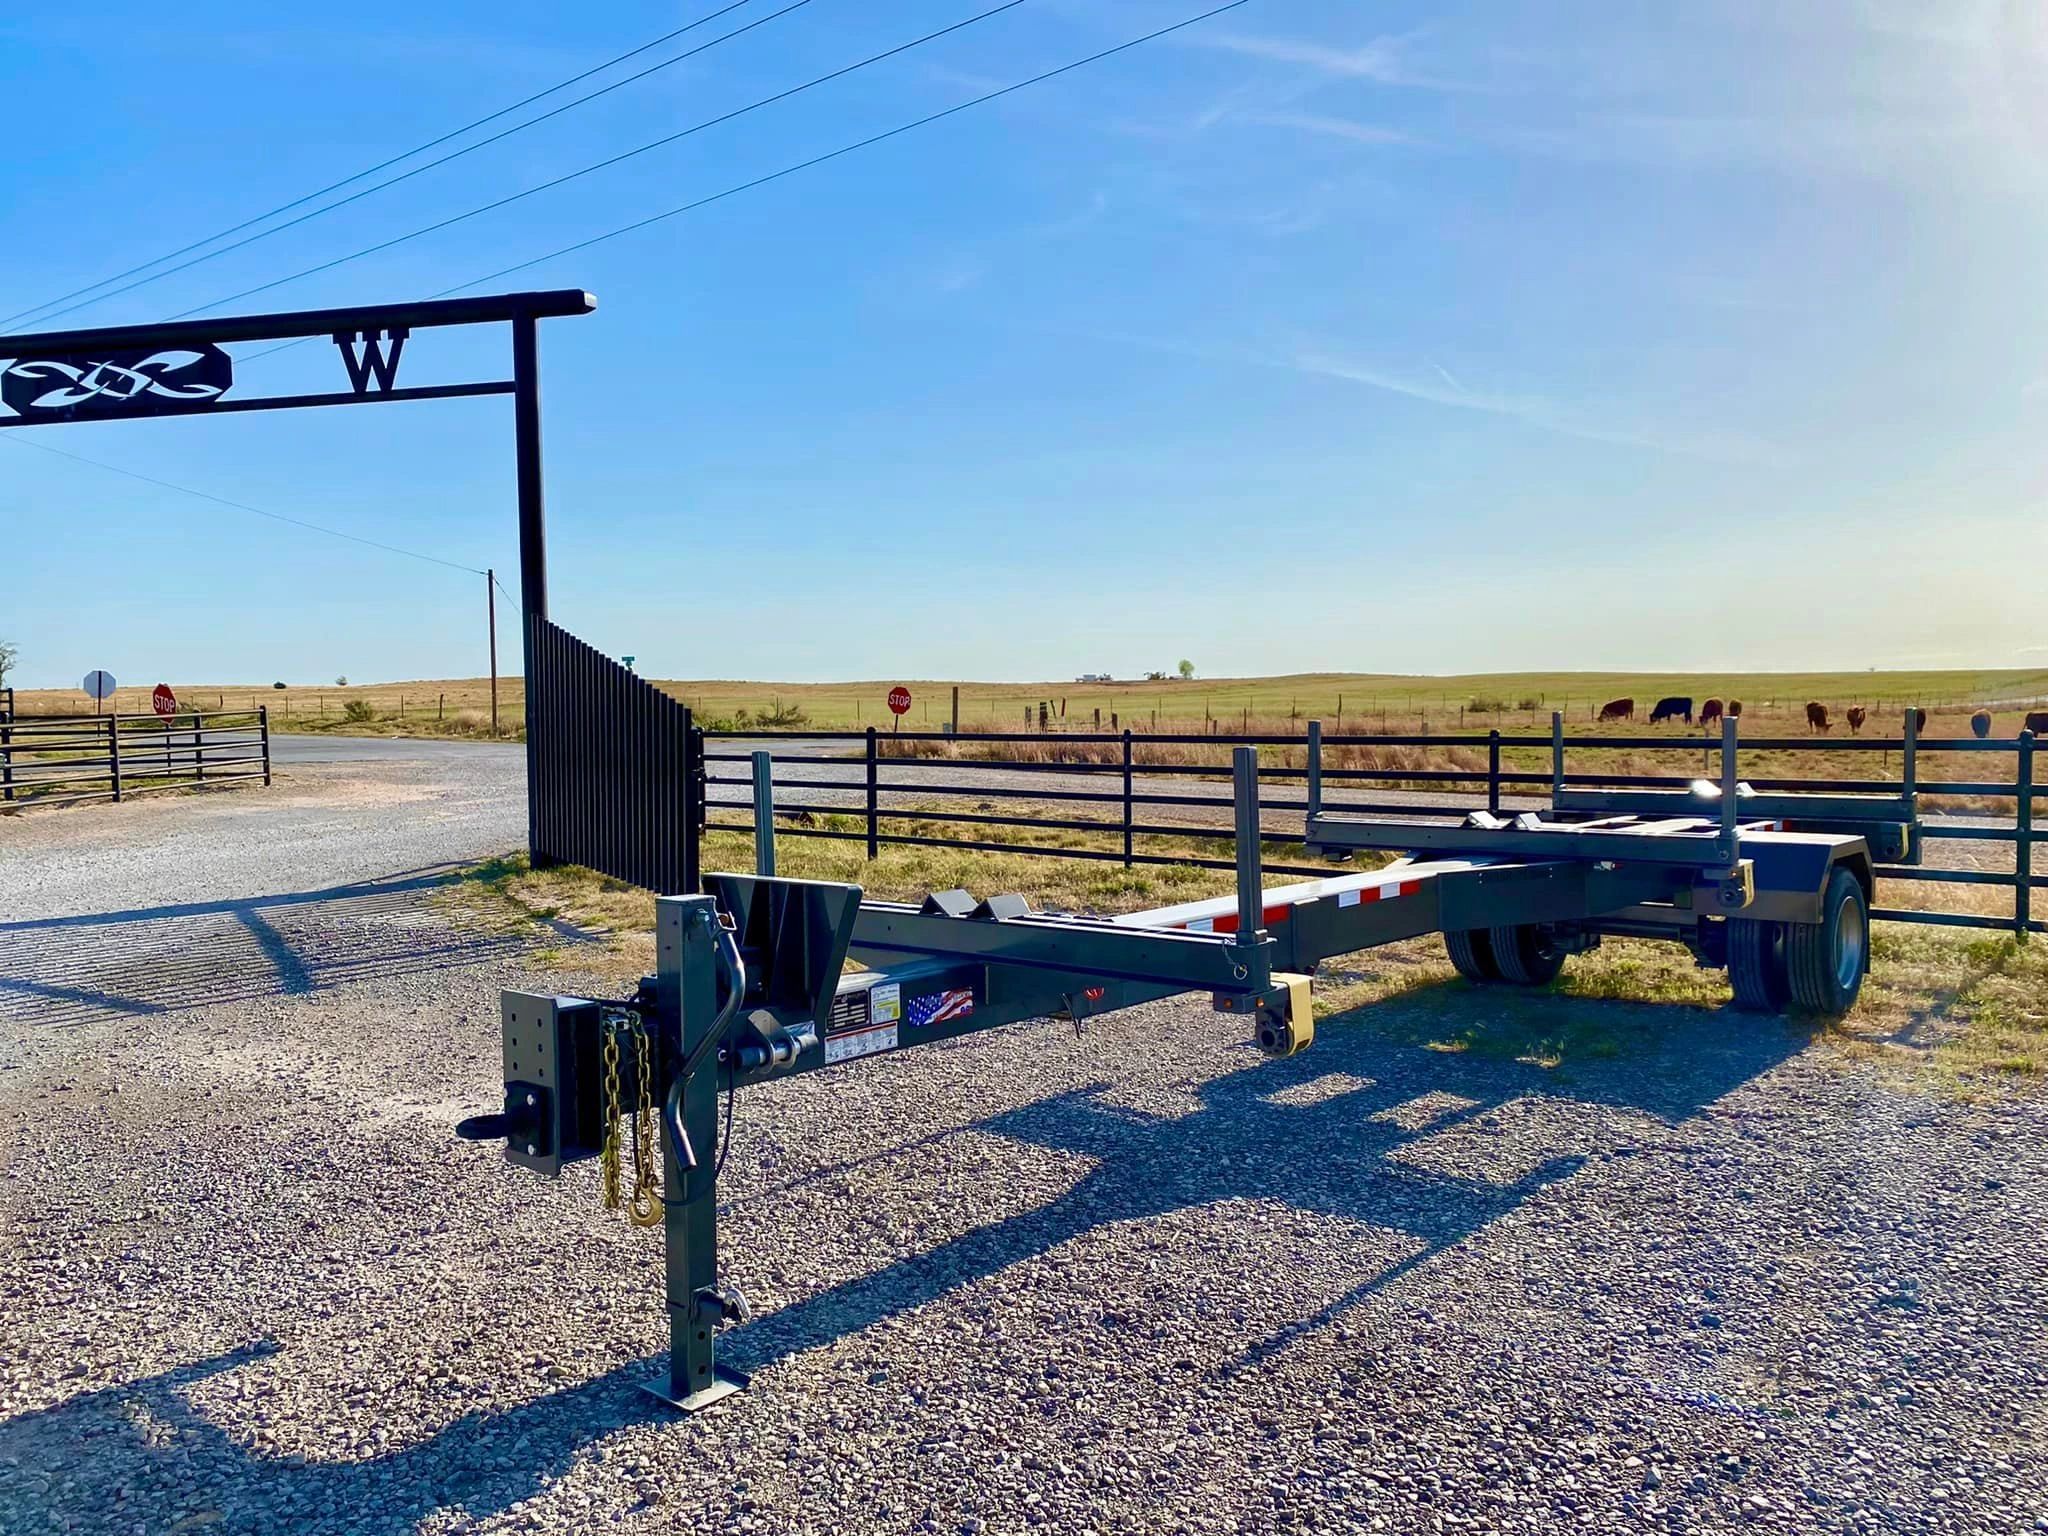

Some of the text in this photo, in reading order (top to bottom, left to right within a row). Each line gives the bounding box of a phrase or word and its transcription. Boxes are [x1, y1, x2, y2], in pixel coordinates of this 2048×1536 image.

[333, 327, 409, 393] W
[154, 694, 175, 713] STOP
[889, 694, 910, 707] STOP
